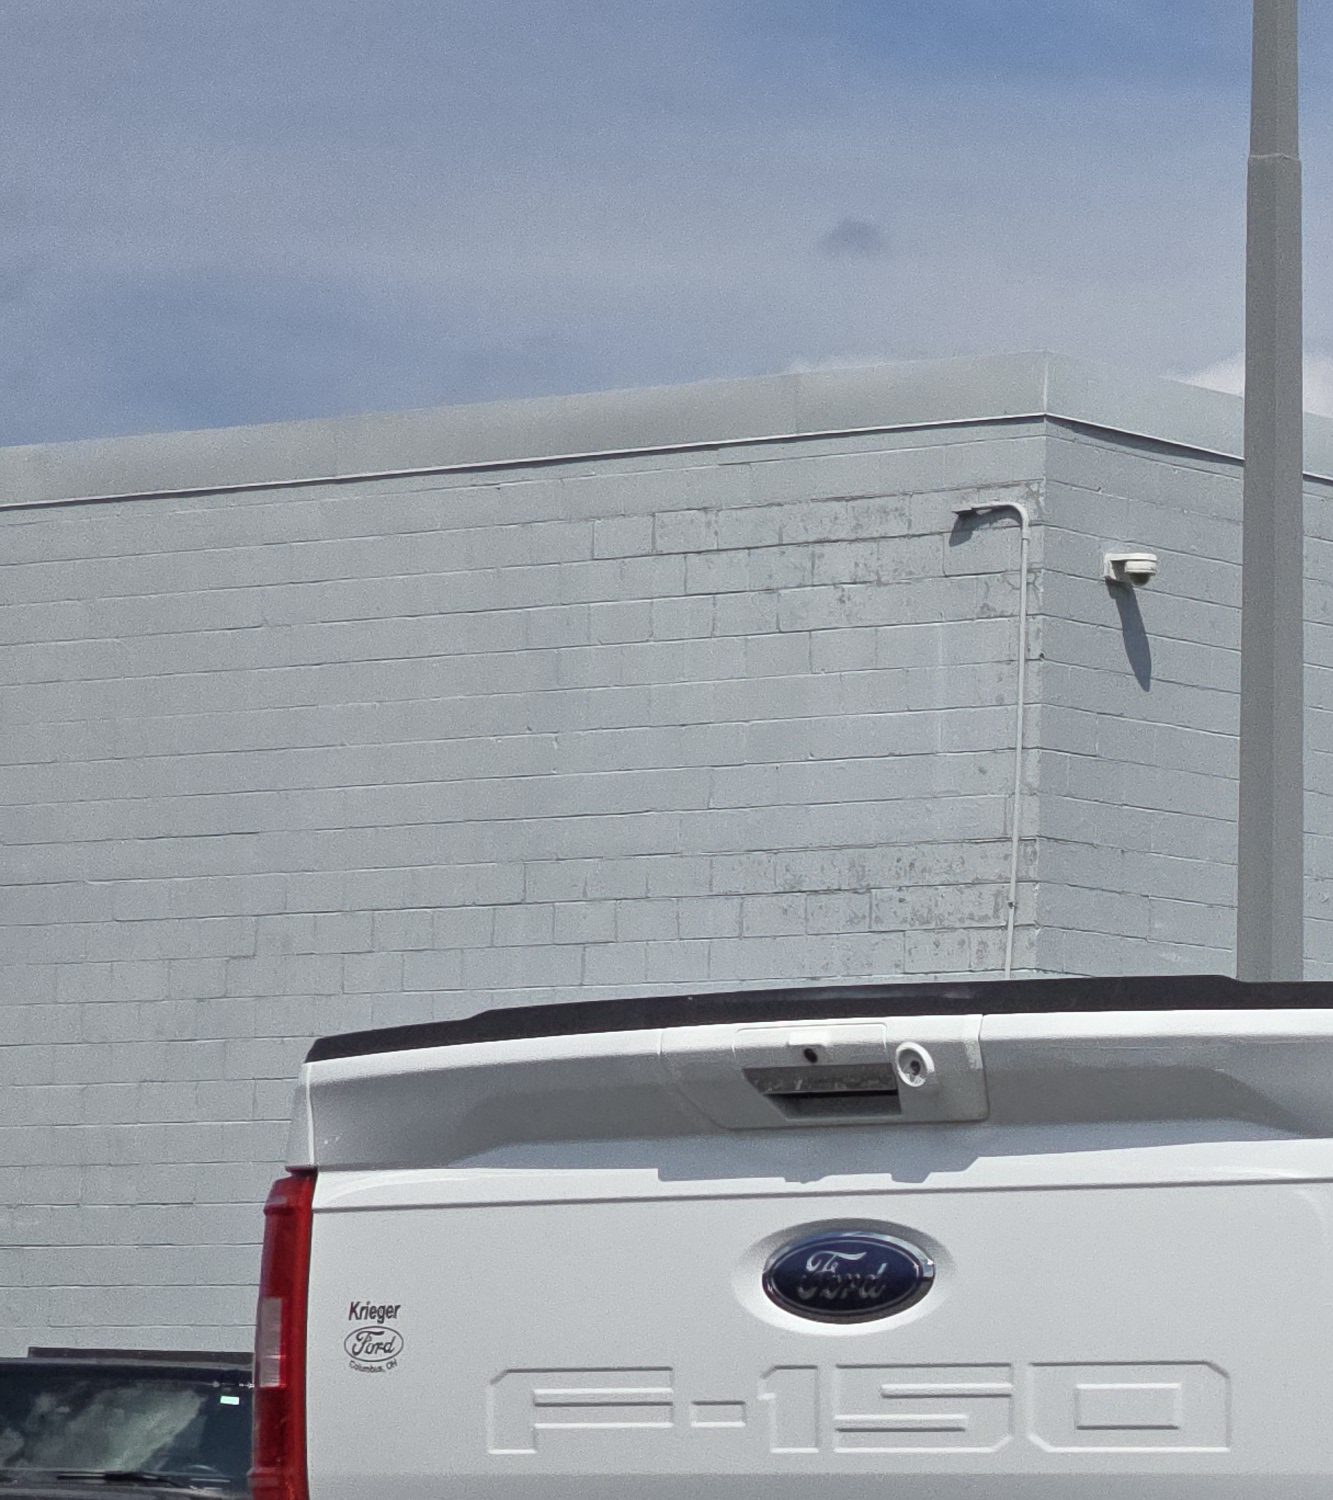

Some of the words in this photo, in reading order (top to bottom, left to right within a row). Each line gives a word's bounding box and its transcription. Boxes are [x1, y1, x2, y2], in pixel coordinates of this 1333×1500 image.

[797, 1250, 889, 1300] Ford
[348, 1300, 402, 1325] Krieger
[351, 1330, 397, 1356] Ford
[487, 1361, 1231, 1455] F-150
